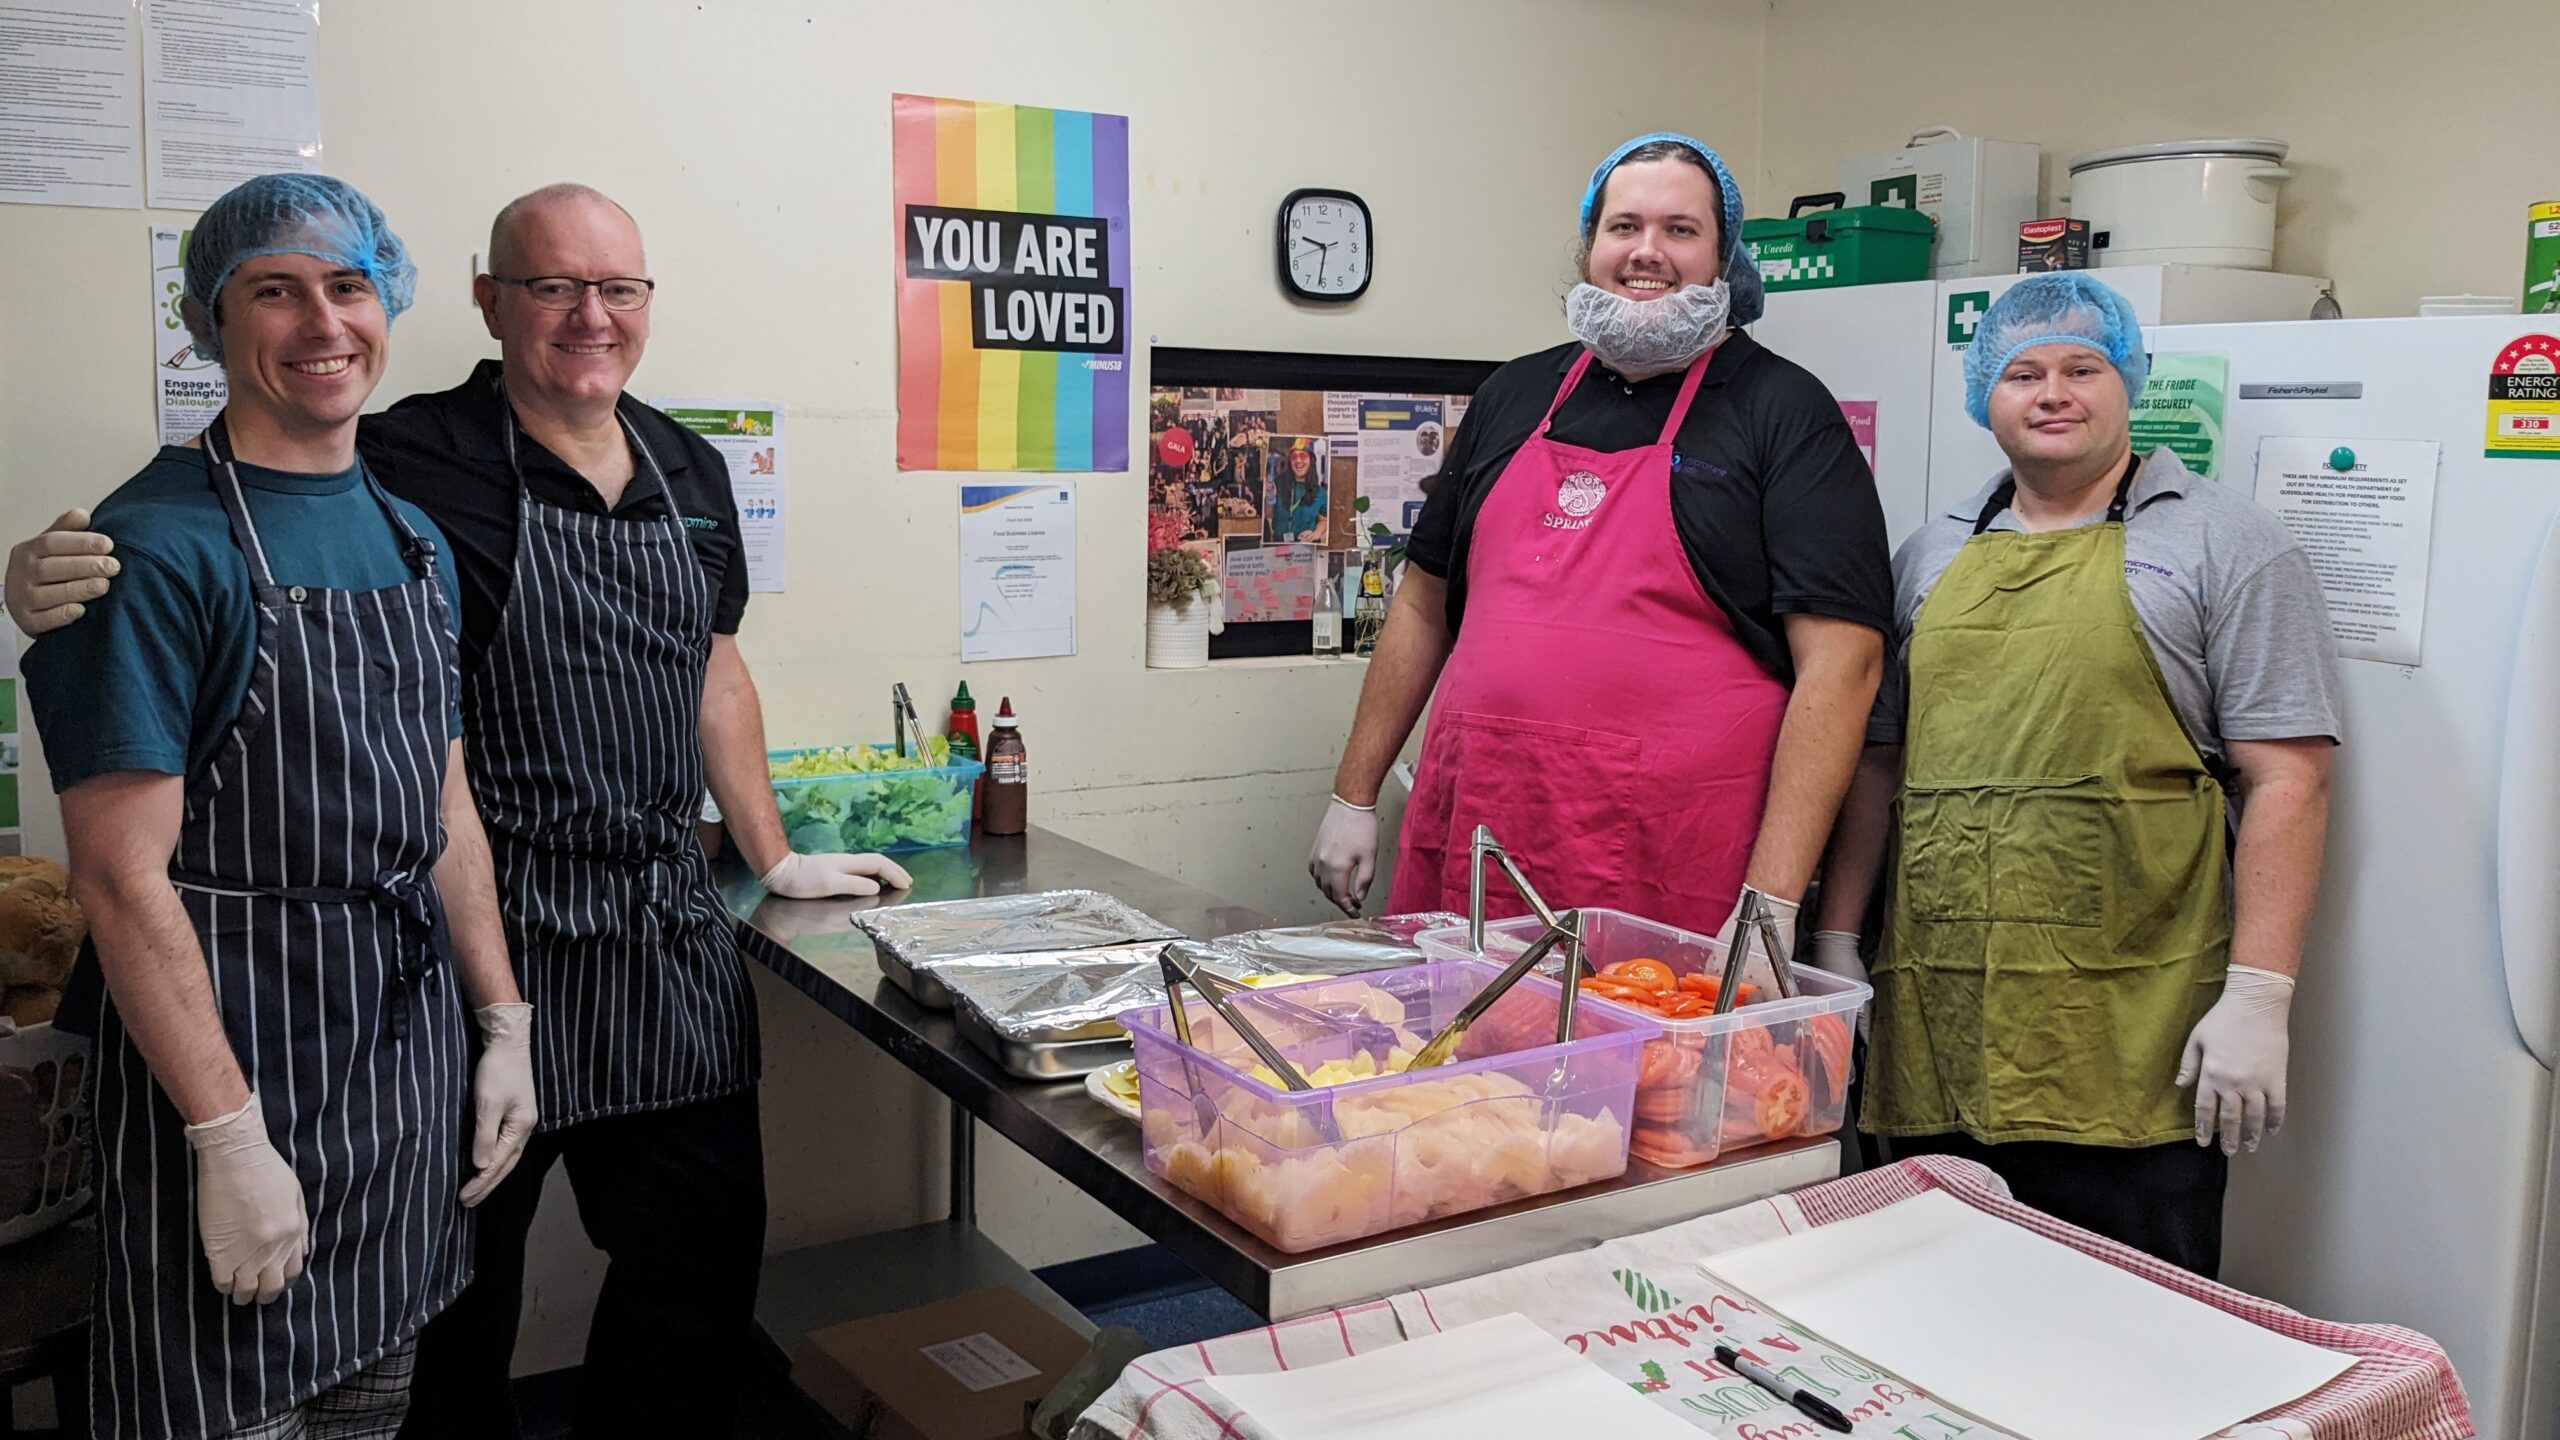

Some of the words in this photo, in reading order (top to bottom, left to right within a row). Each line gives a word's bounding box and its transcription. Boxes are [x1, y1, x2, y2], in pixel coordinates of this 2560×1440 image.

[1302, 205, 1311, 216] 11
[1318, 205, 1328, 216] 12
[1292, 220, 1301, 230] 10
[1349, 223, 1355, 233] 2
[2023, 224, 2062, 235] Elastoplast
[914, 216, 1000, 273] YOU
[1014, 224, 1098, 279] ARE
[1290, 240, 1296, 250] 9
[1351, 243, 1357, 254] 3
[1292, 260, 1299, 270] 8
[1349, 263, 1355, 273] 4
[1305, 275, 1311, 285] 7
[1337, 277, 1343, 287] 5
[984, 288, 1115, 344] LOVED
[165, 379, 211, 390] Engage
[215, 380, 226, 388] in
[2148, 380, 2164, 390] THE
[2166, 379, 2196, 391] FRIDGE
[2507, 376, 2560, 387] ENERGY
[2508, 388, 2558, 398] RATING
[2152, 398, 2194, 409] SECURELY
[2520, 420, 2540, 429] 330
[1168, 441, 1185, 454] GALA
[2124, 560, 2172, 577] micromine
